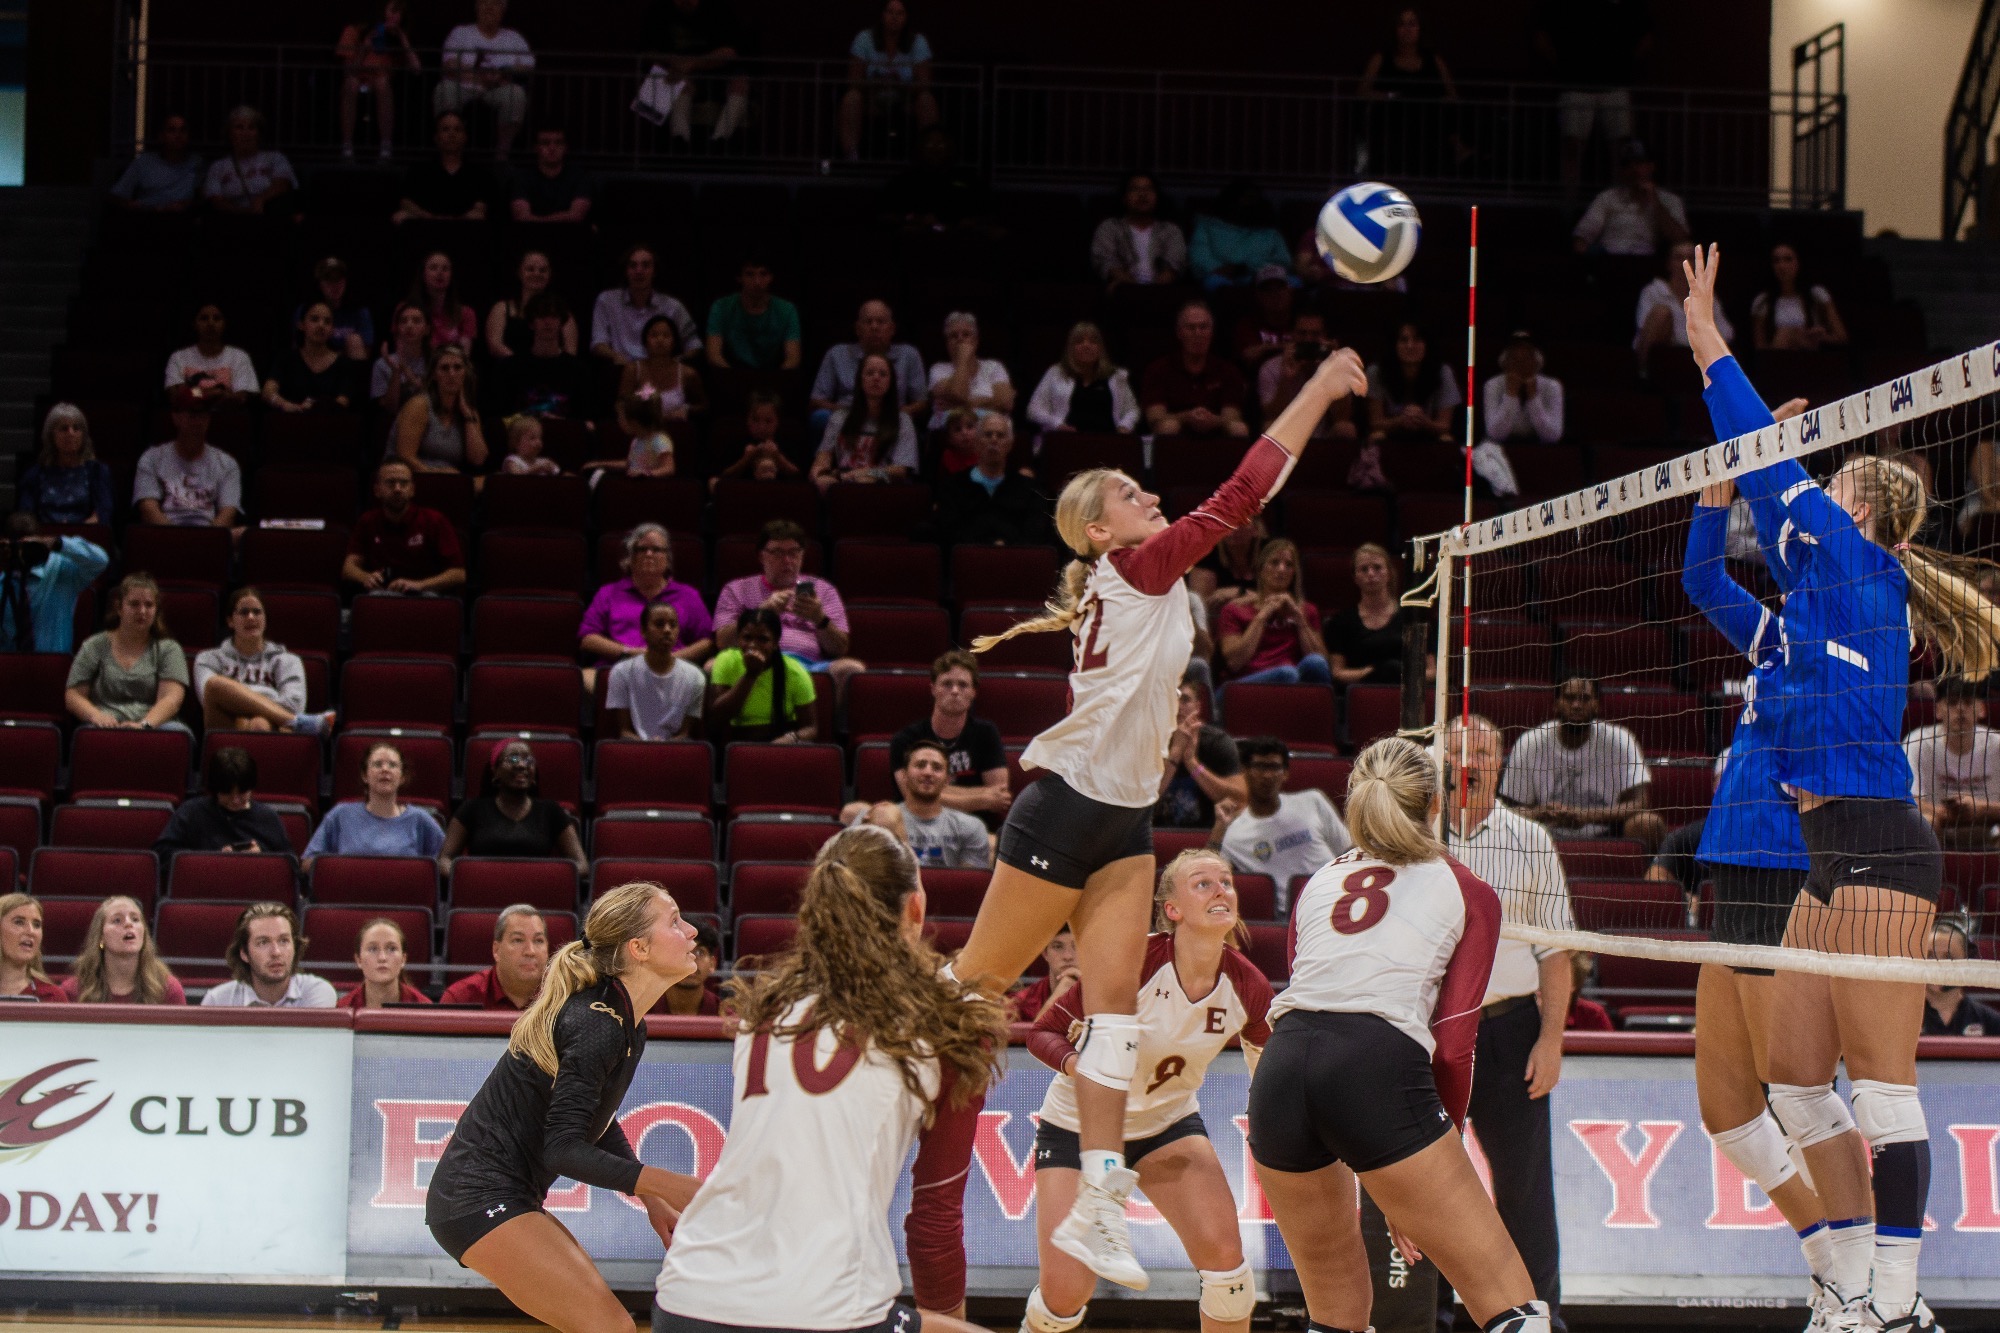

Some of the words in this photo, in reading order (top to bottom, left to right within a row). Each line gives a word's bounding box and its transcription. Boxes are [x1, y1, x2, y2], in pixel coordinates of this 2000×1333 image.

[1540, 501, 1555, 527] CAA
[1655, 462, 1672, 492] CAA
[1723, 438, 1741, 470] CAA
[1800, 410, 1821, 445] CAA
[1890, 376, 1914, 413] CAA
[1962, 352, 1972, 389] E
[1329, 865, 1398, 936] 8
[589, 1001, 624, 1027] CAA
[1203, 1007, 1227, 1034] E
[129, 1095, 308, 1137] CLUB
[0, 1190, 159, 1233] DAY!
[1676, 1298, 1788, 1309] DAKTRONICS
